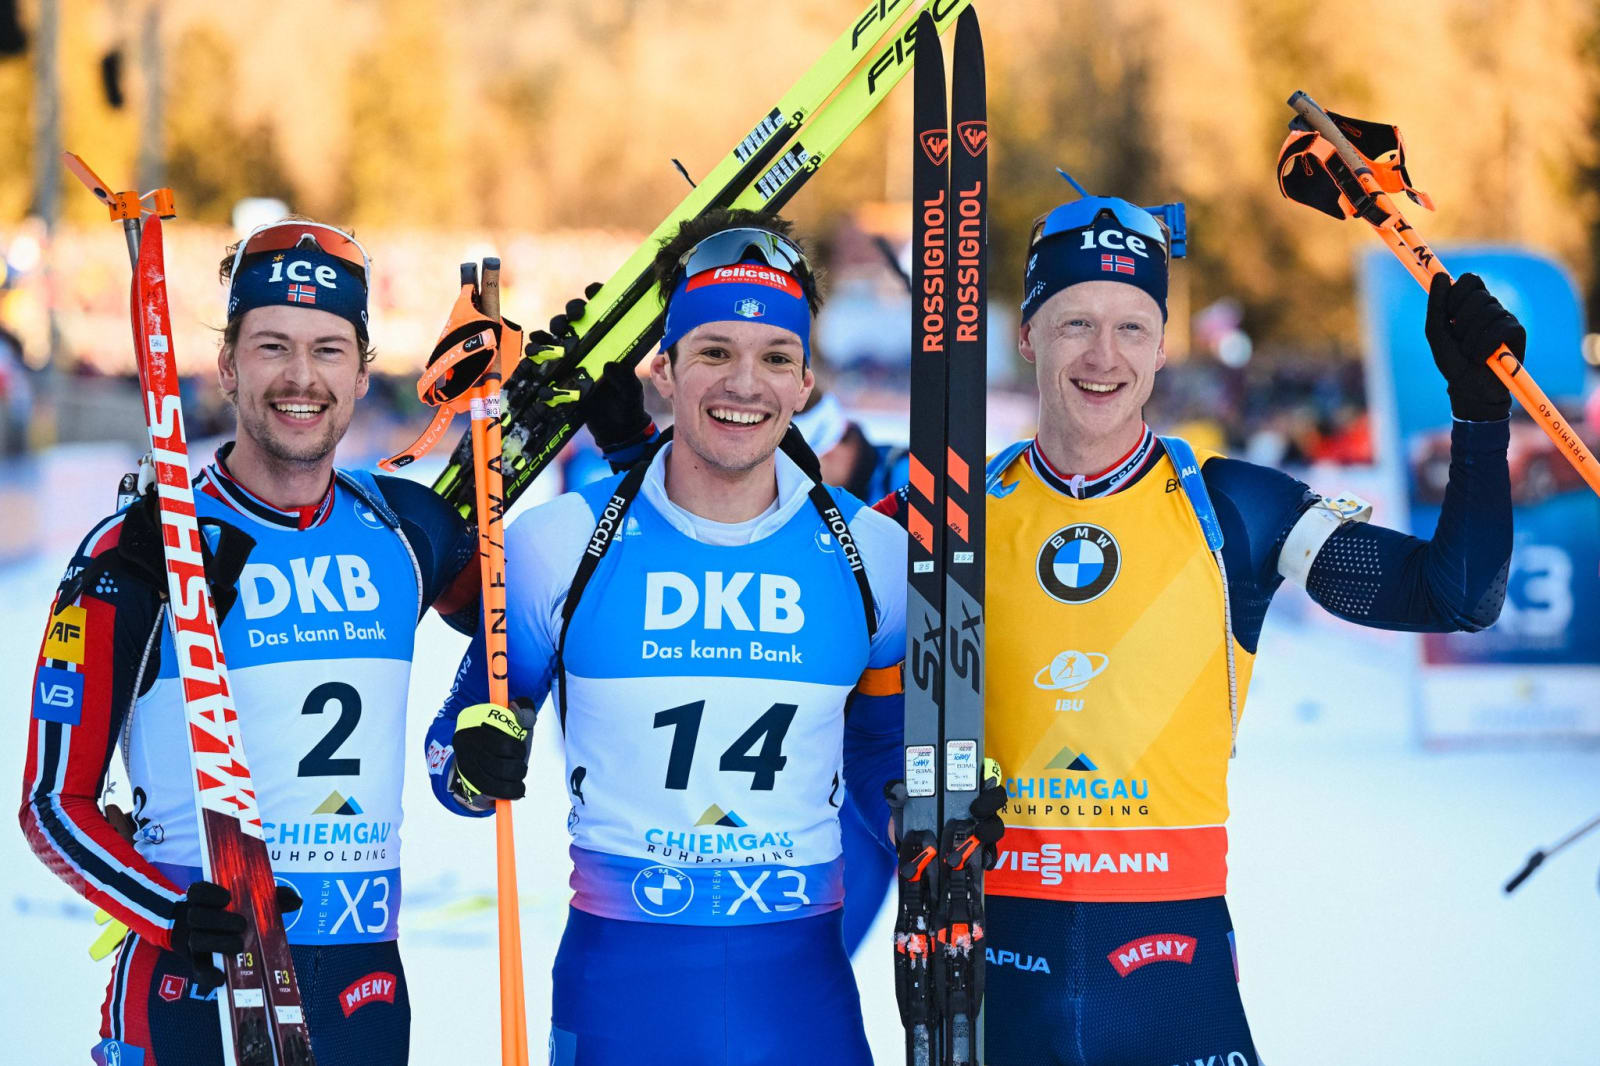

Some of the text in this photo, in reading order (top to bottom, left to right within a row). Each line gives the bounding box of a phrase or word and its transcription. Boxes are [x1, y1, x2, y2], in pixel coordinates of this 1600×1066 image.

[1080, 229, 1149, 258] ice
[268, 256, 337, 289] ice
[713, 267, 787, 287] felicetti
[923, 189, 945, 352] ROSSIGNOL
[956, 180, 981, 342] ROSSIGNOL
[1539, 403, 1587, 463] PREMIO 40
[506, 423, 572, 498] FISCHER
[587, 495, 626, 557] FIOCCHI
[824, 507, 863, 573] FIOCCHI
[1050, 527, 1112, 550] BMW
[239, 555, 380, 620] DKB
[643, 571, 805, 634] DKB
[148, 391, 241, 819] MADSHUS
[248, 621, 387, 648] Das kann Bank
[641, 639, 803, 664] Das kann Bank
[1055, 698, 1084, 712] IBU
[297, 681, 362, 778] 2
[653, 699, 799, 791] 14
[1006, 778, 1149, 799] CHIEMGAU
[1001, 804, 1149, 816] RUHPOLDING
[262, 822, 391, 845] CHIEMGAU
[645, 828, 794, 855] CHIEMGAU
[271, 849, 386, 862] UHPOLDING
[642, 868, 687, 881] BMW
[318, 880, 331, 935] THE NEW
[329, 876, 390, 935] X3
[712, 869, 722, 916] THE NEW
[726, 869, 811, 916] X3
[985, 947, 1051, 974] APUA
[1118, 940, 1189, 968] MENY
[346, 980, 391, 1007] MENY
